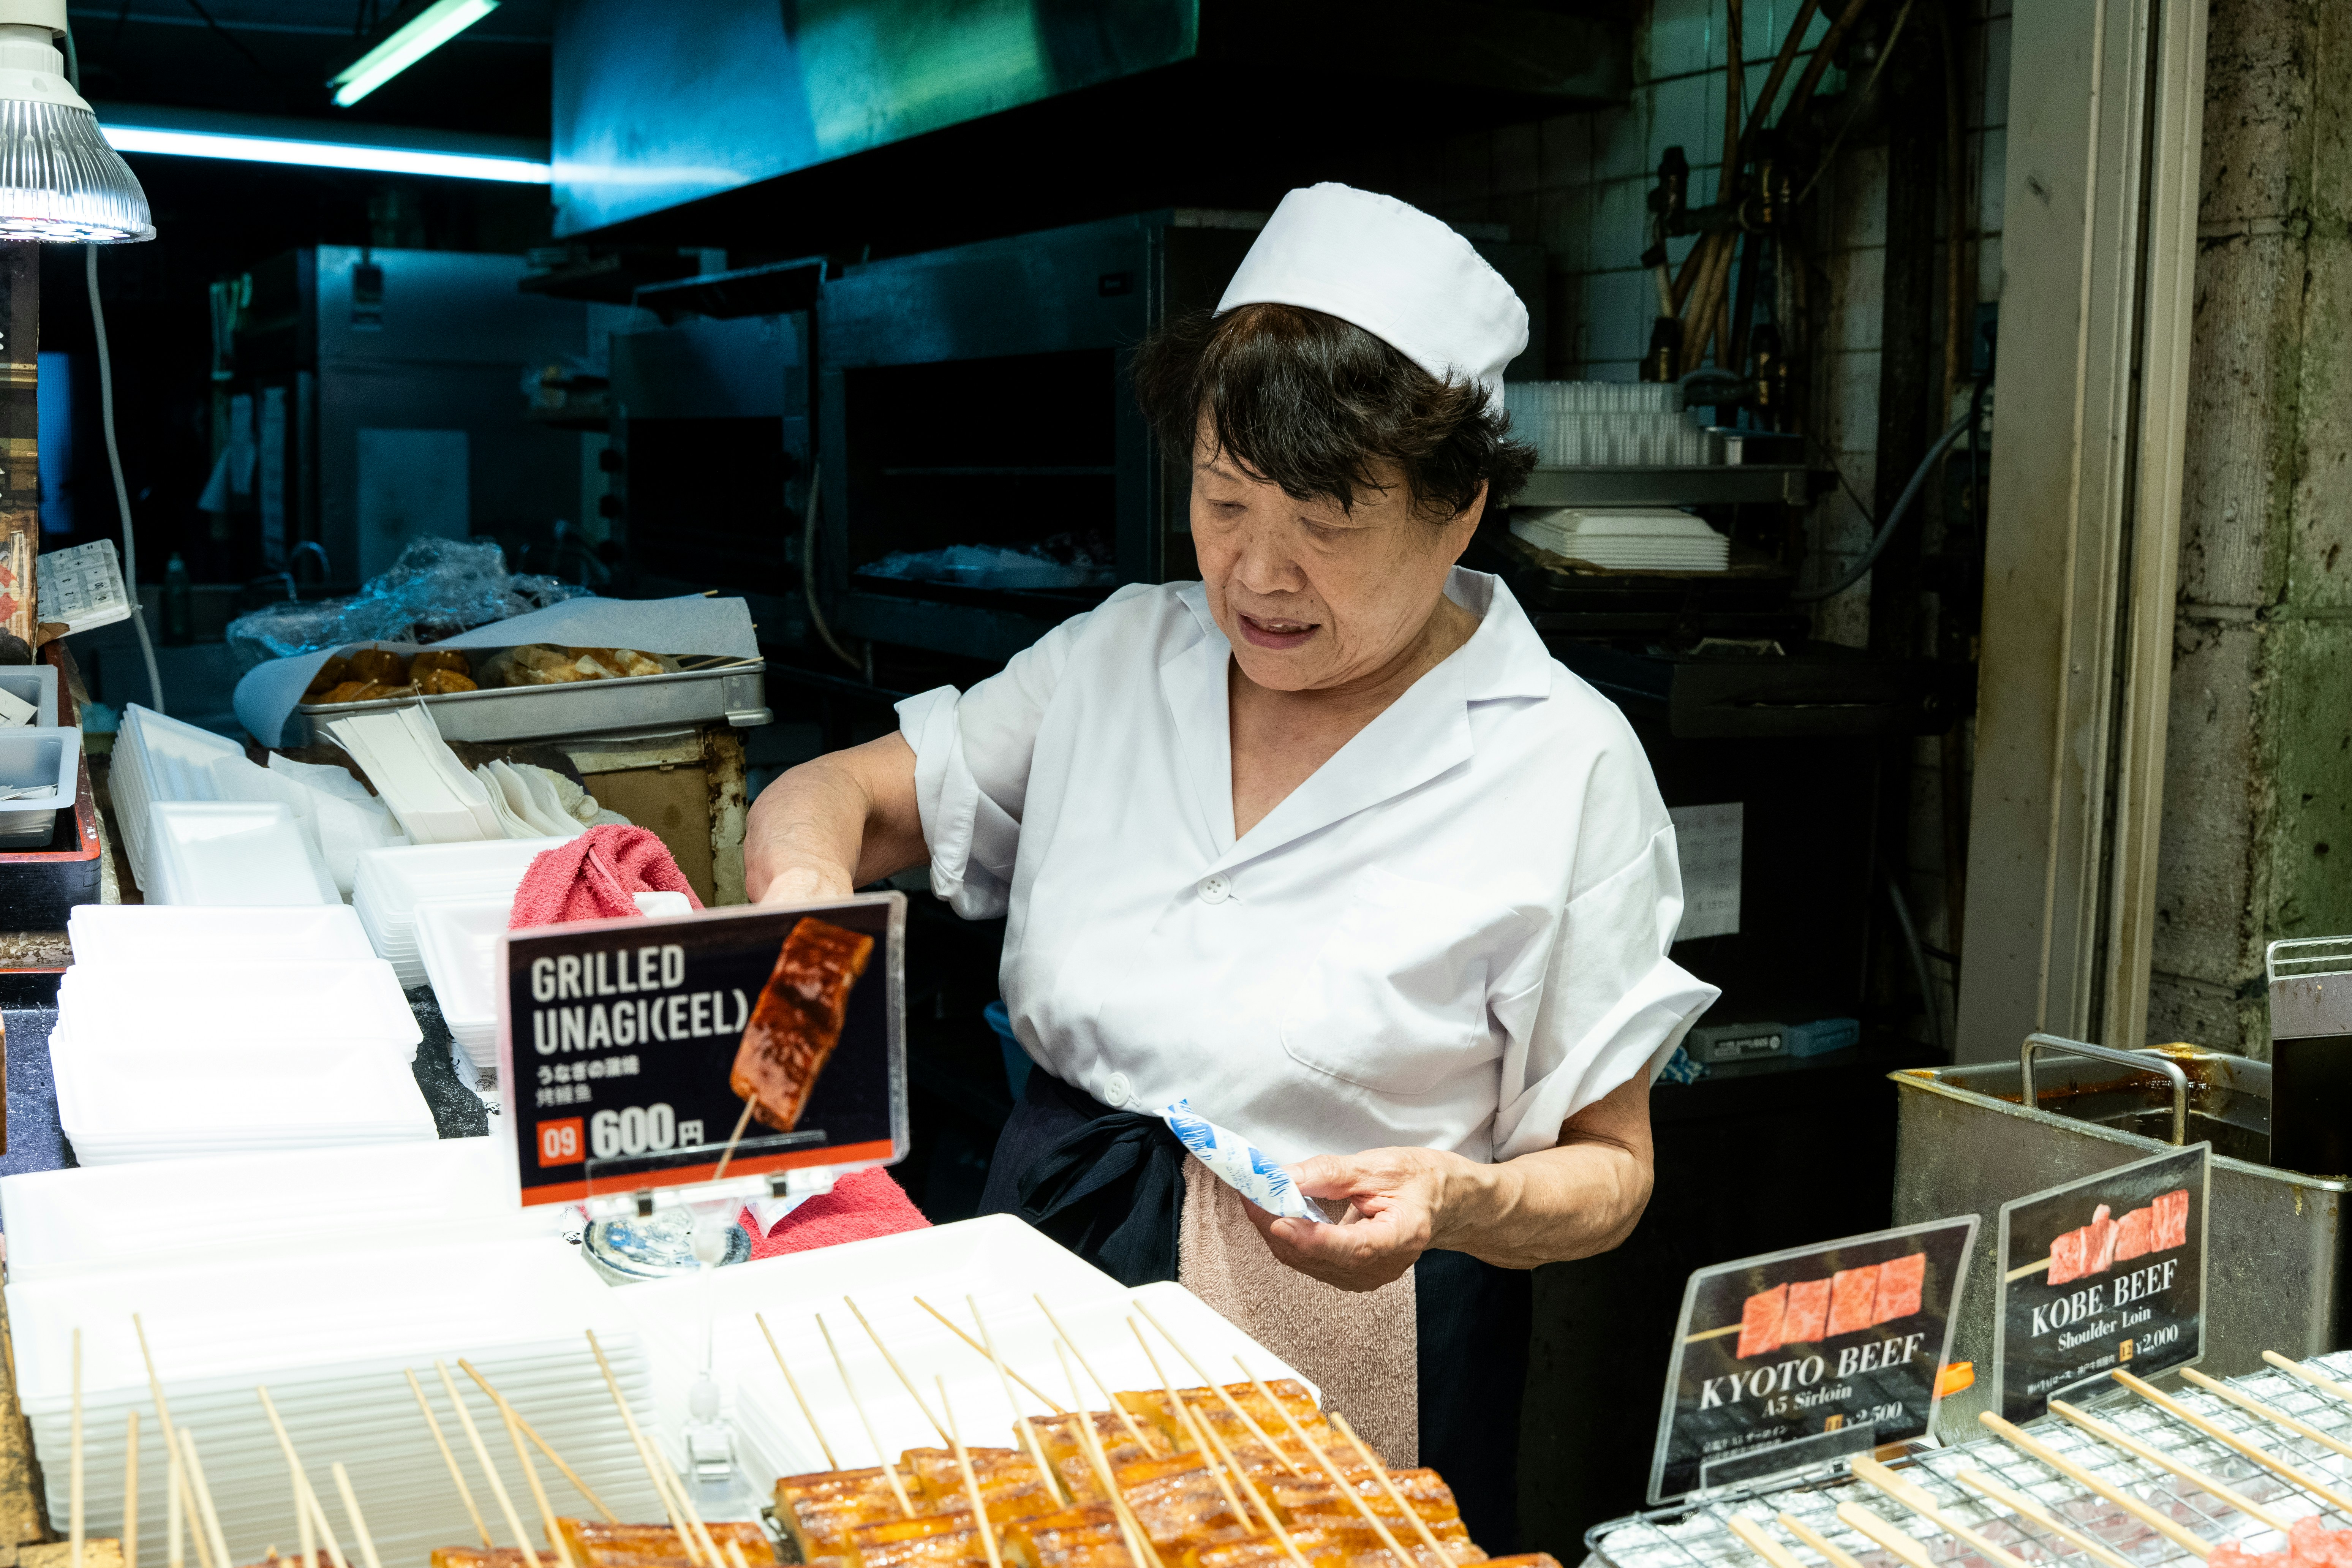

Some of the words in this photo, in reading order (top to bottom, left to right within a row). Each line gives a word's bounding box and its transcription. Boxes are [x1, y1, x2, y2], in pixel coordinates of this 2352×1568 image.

[532, 944, 685, 1003] GRILLED
[533, 988, 749, 1056] UNAGI(EEL)
[544, 1126, 577, 1159] 09
[2030, 1284, 2104, 1338] KOBE
[2112, 1258, 2178, 1308] BEEF
[2058, 1319, 2118, 1352] Shoulder
[2121, 1306, 2152, 1329] Loin
[1698, 1355, 1825, 1412] KYOTO
[1834, 1332, 1925, 1379] BEEF
[1761, 1395, 1788, 1418] A5
[1793, 1383, 1853, 1411] Sirloin
